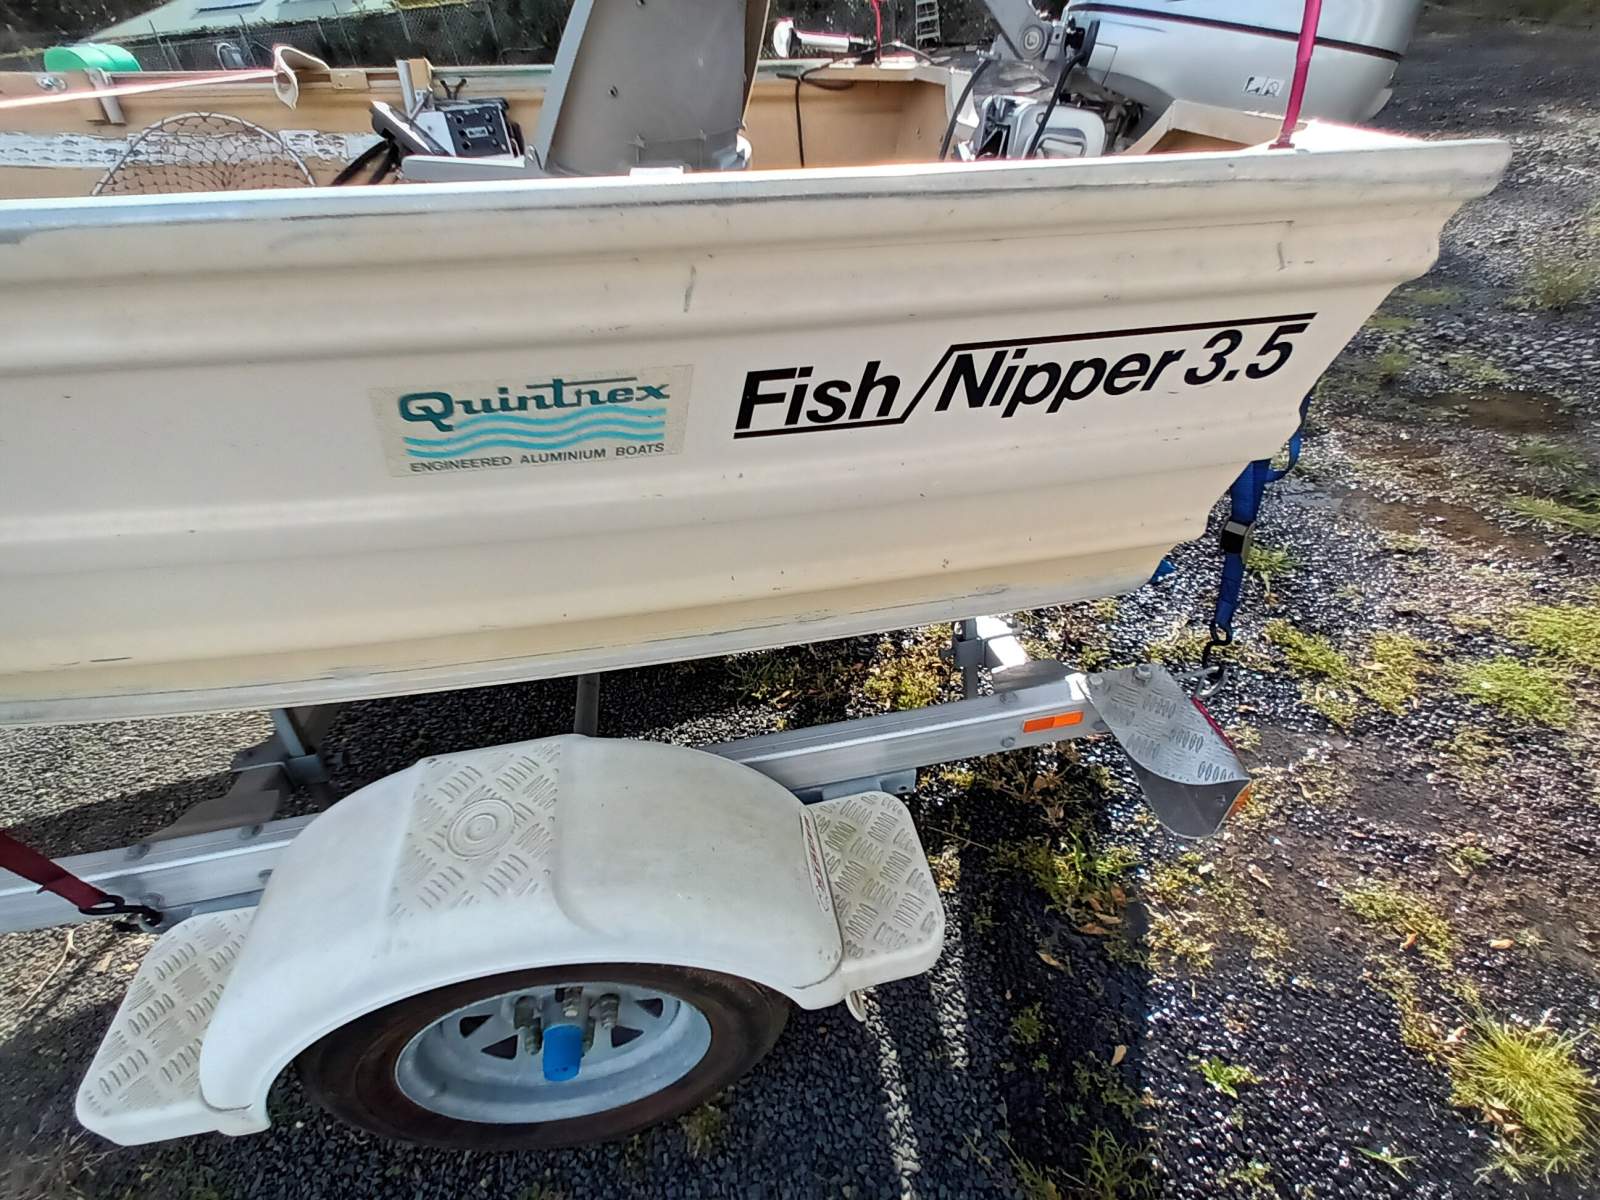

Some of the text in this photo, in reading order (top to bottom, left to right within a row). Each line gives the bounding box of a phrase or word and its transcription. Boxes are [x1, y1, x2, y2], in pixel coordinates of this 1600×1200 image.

[1183, 322, 1310, 386] 3.5
[398, 377, 671, 432] Quintrex
[409, 442, 665, 473] ENGINEERED ALUMINIUM BOATS
